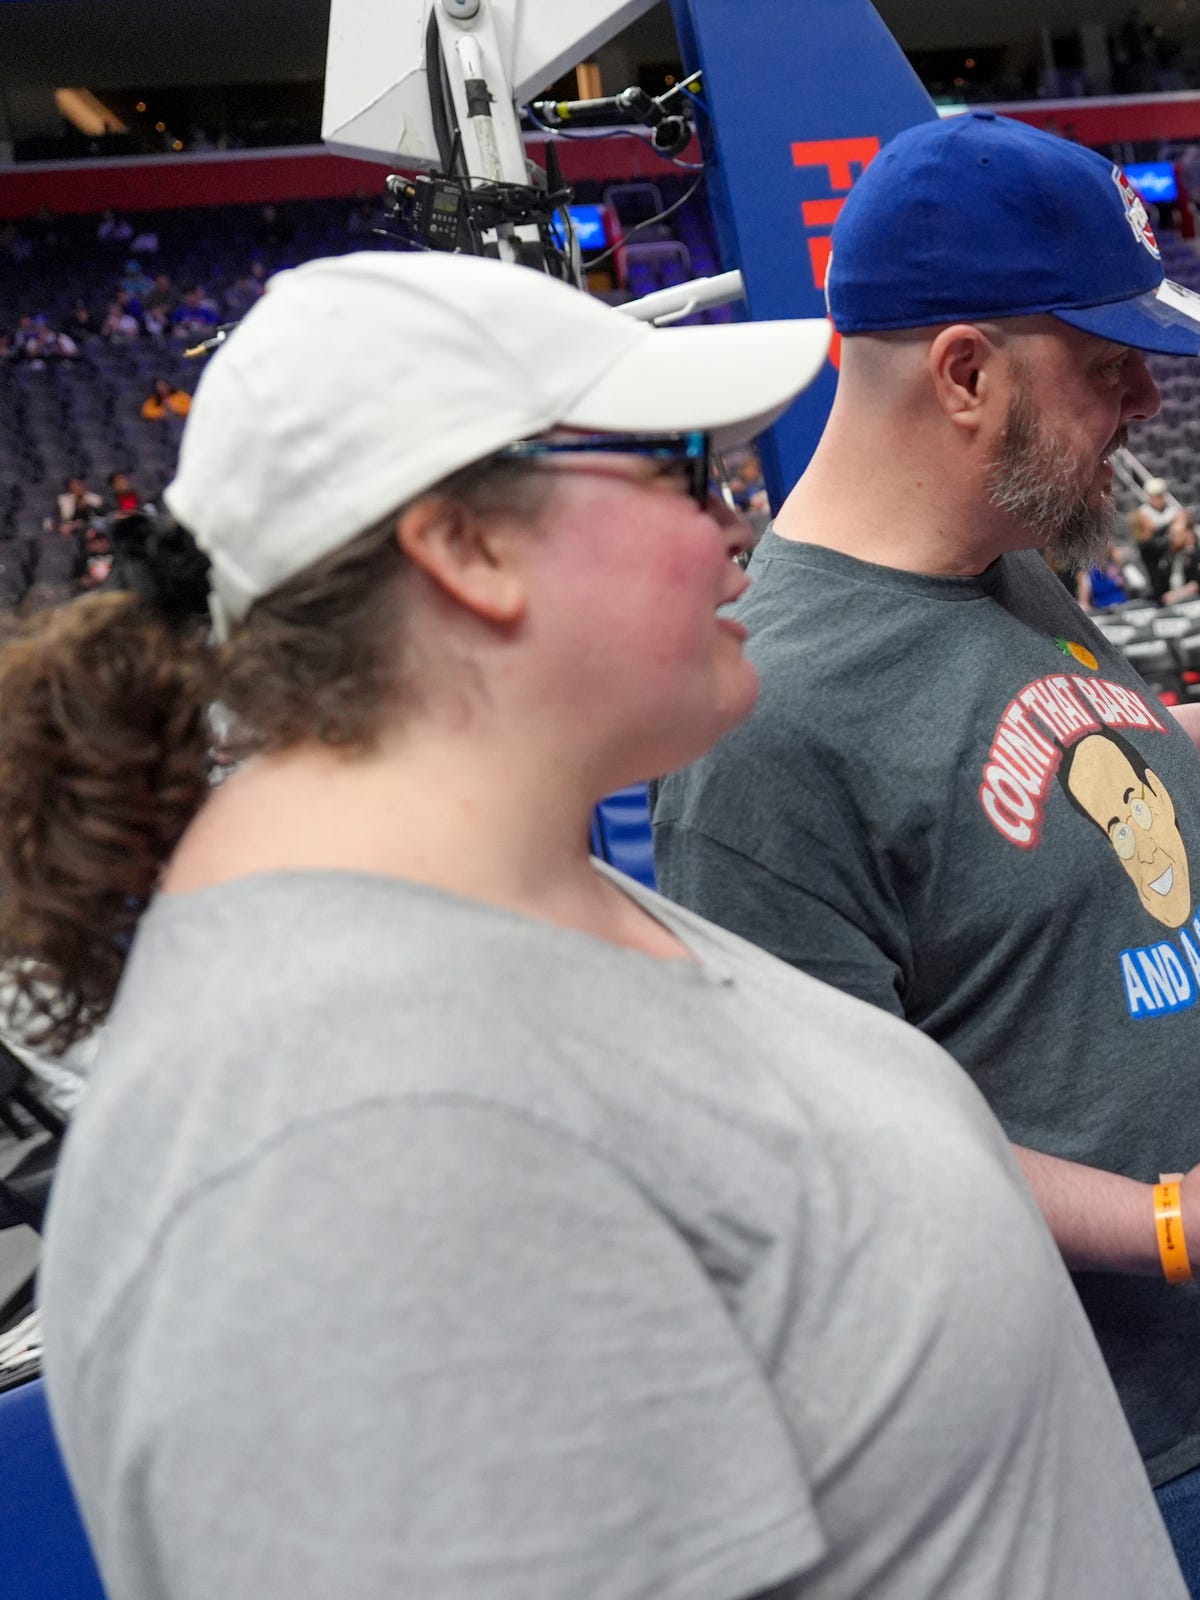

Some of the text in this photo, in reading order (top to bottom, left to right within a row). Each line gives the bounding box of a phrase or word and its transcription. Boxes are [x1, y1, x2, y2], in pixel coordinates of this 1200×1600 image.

[980, 675, 1164, 844] COUNT THAT BABY
[1120, 942, 1192, 1013] AND
